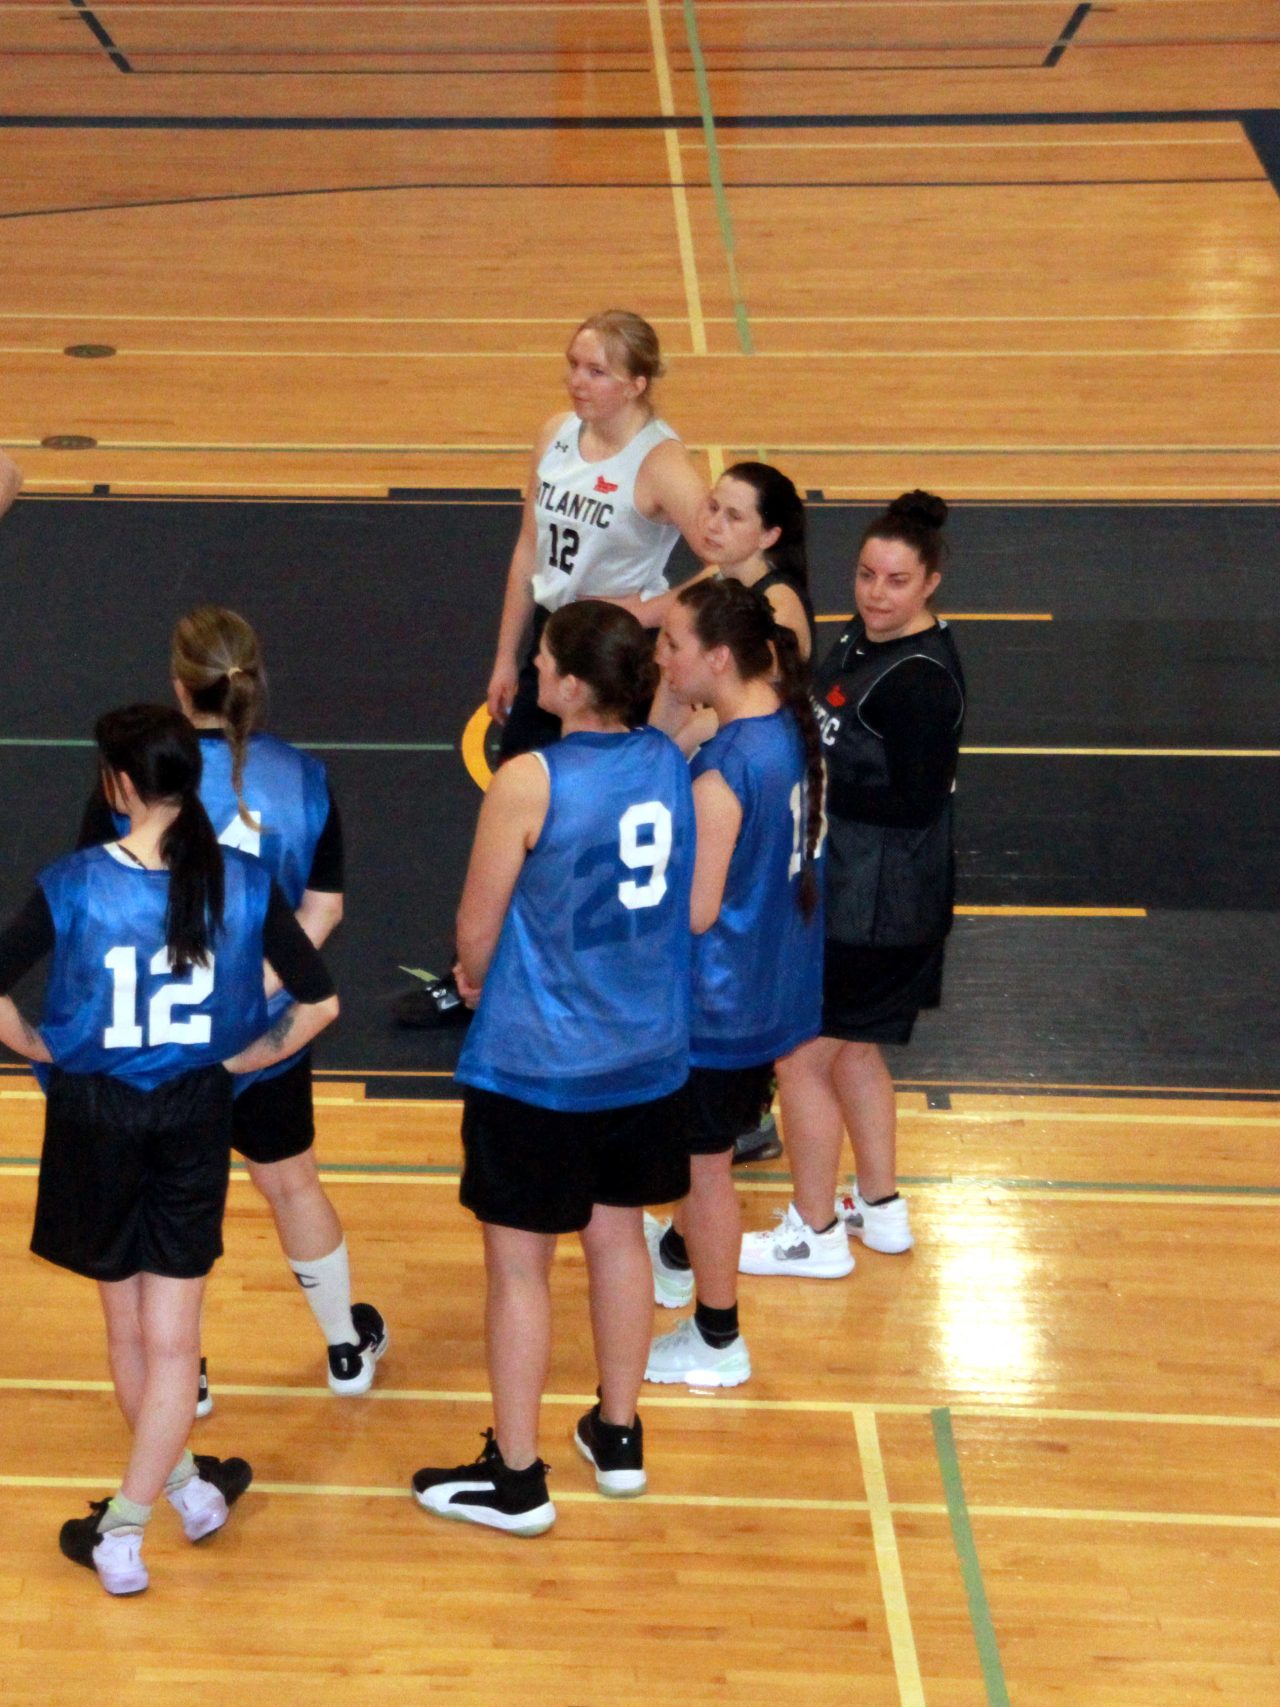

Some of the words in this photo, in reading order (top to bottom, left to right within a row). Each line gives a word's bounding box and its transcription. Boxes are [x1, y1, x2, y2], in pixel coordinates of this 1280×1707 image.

[548, 522, 580, 577] 12
[617, 801, 672, 910] 9
[103, 945, 216, 1050] 12
